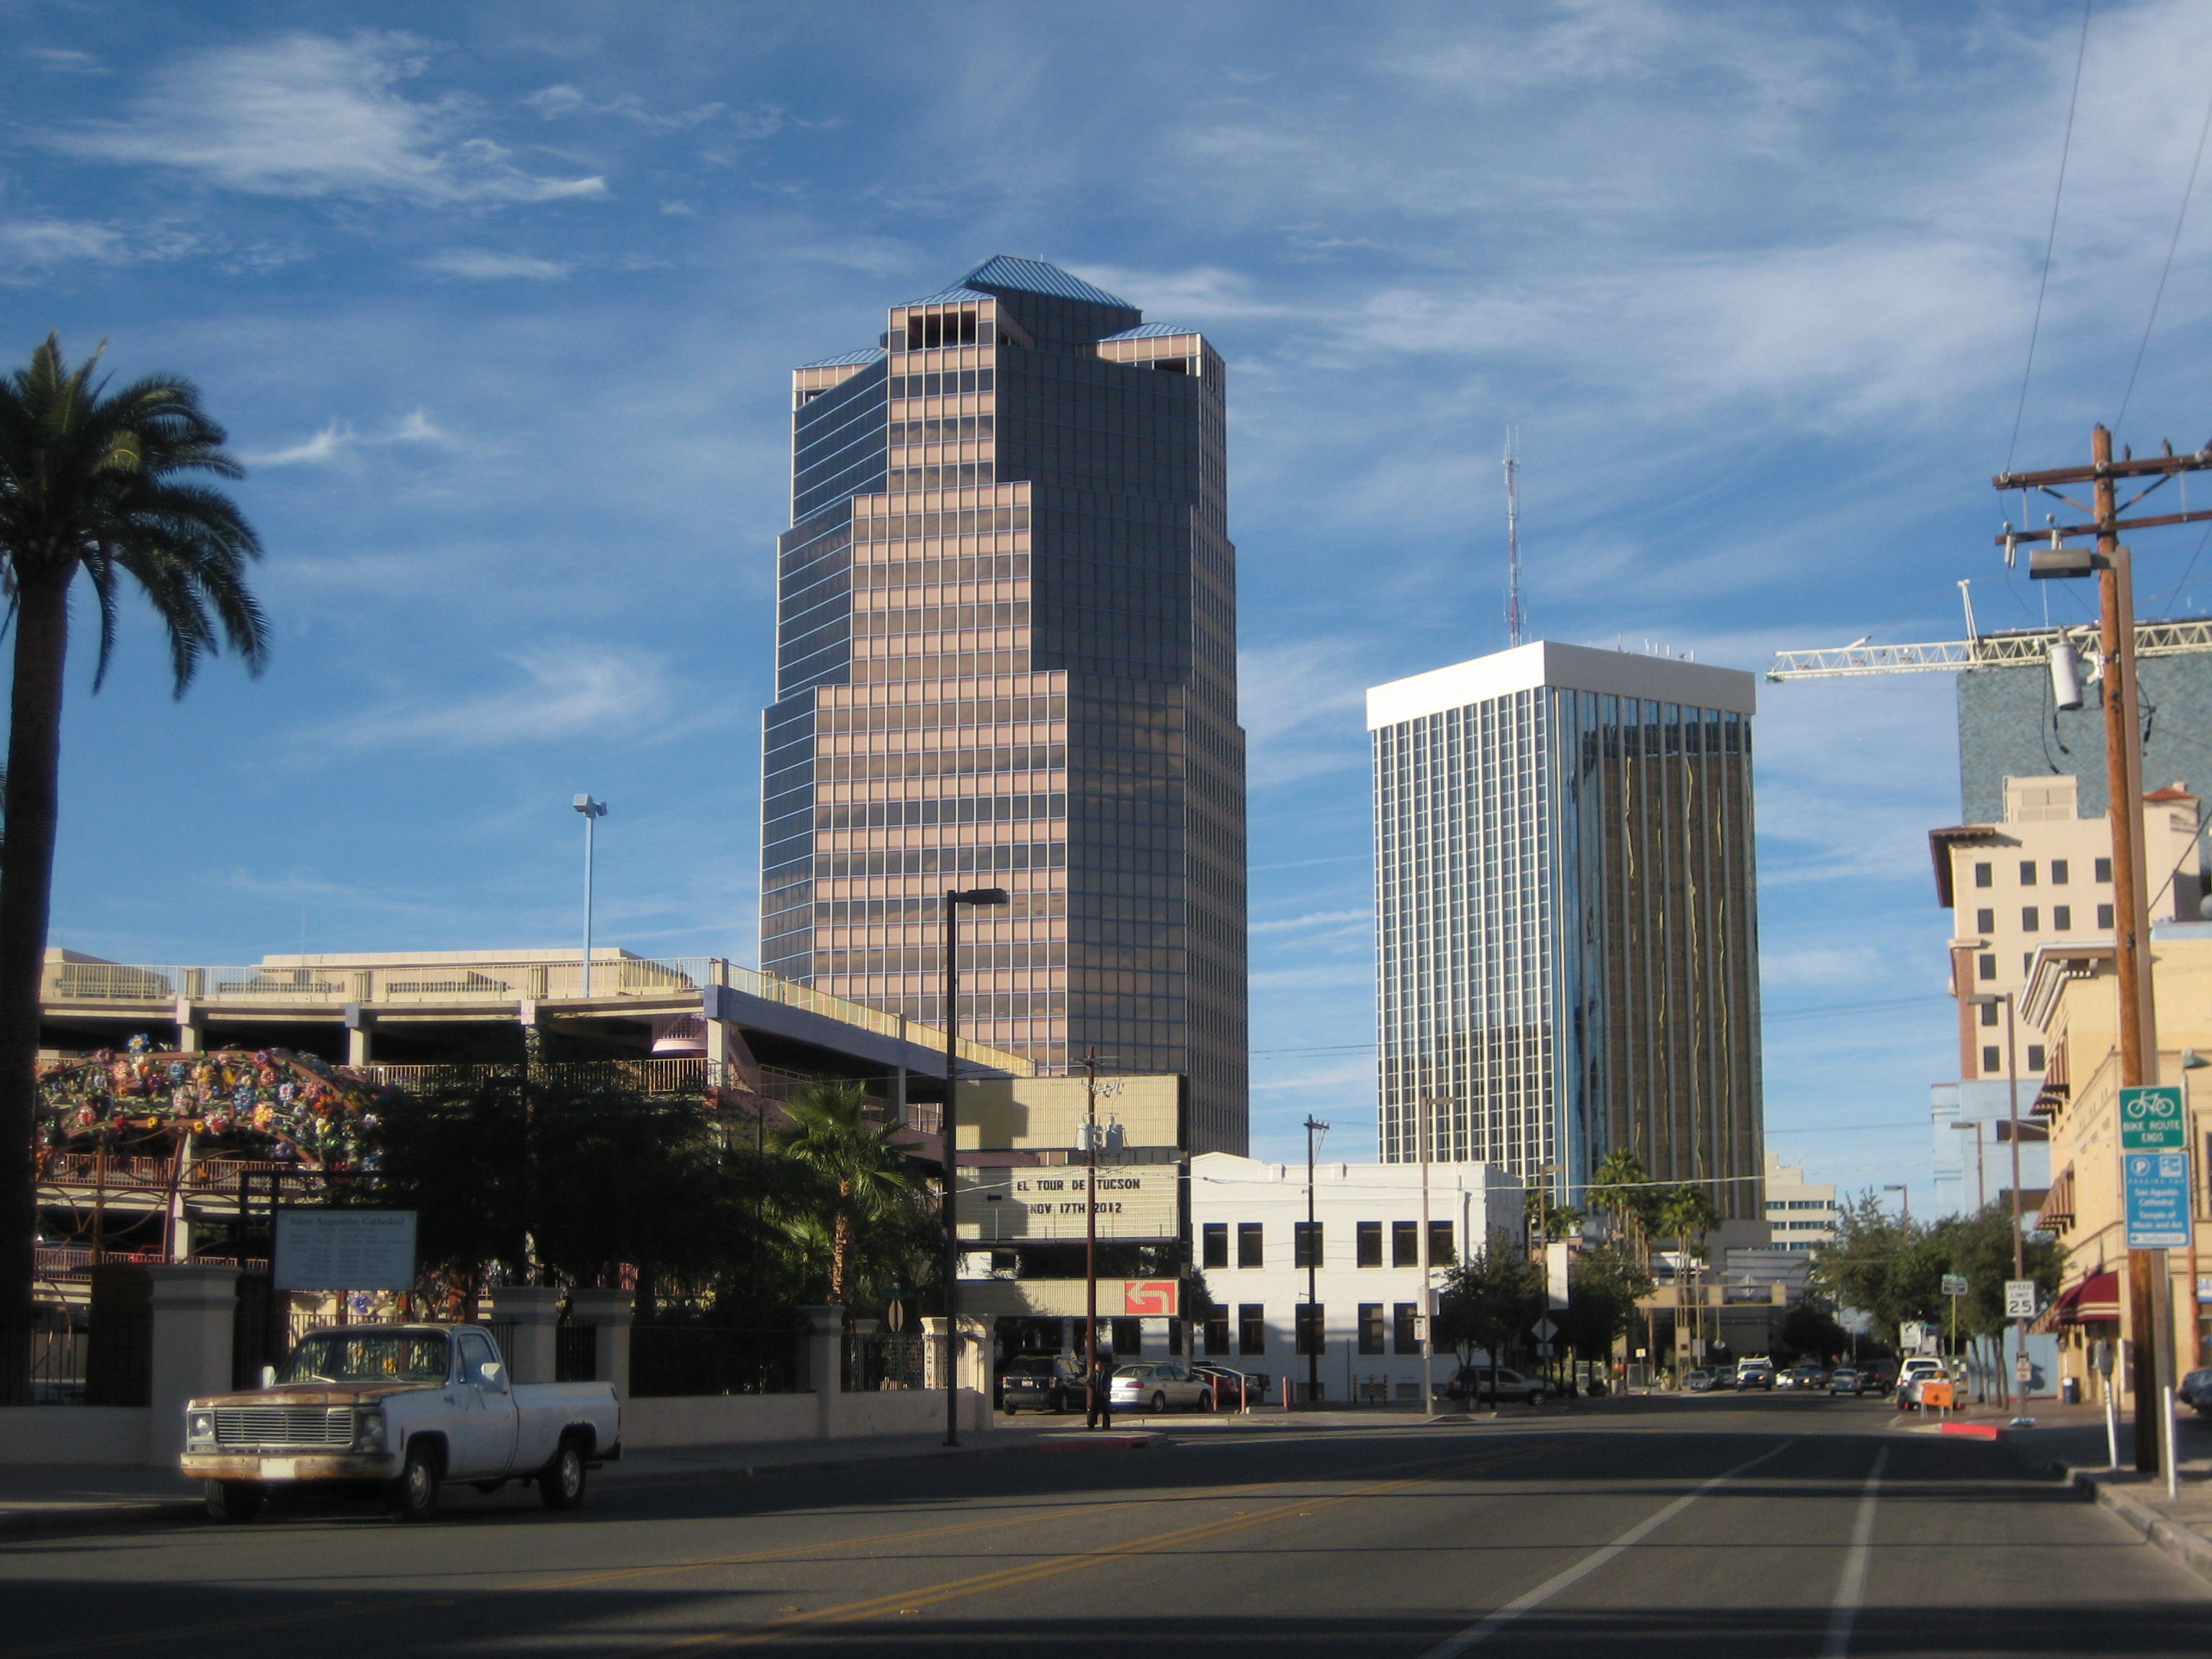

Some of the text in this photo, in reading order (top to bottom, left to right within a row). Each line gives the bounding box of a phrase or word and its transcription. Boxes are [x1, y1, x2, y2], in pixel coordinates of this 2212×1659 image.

[2123, 1120, 2181, 1131] BIKE ROUTE
[2141, 1132, 2164, 1143] ENDS
[1017, 1178, 1141, 1191] EL TOUR DE TUCSON
[1030, 1202, 1122, 1214] NOV 17TH 2012
[2010, 1300, 2032, 1313] 25
